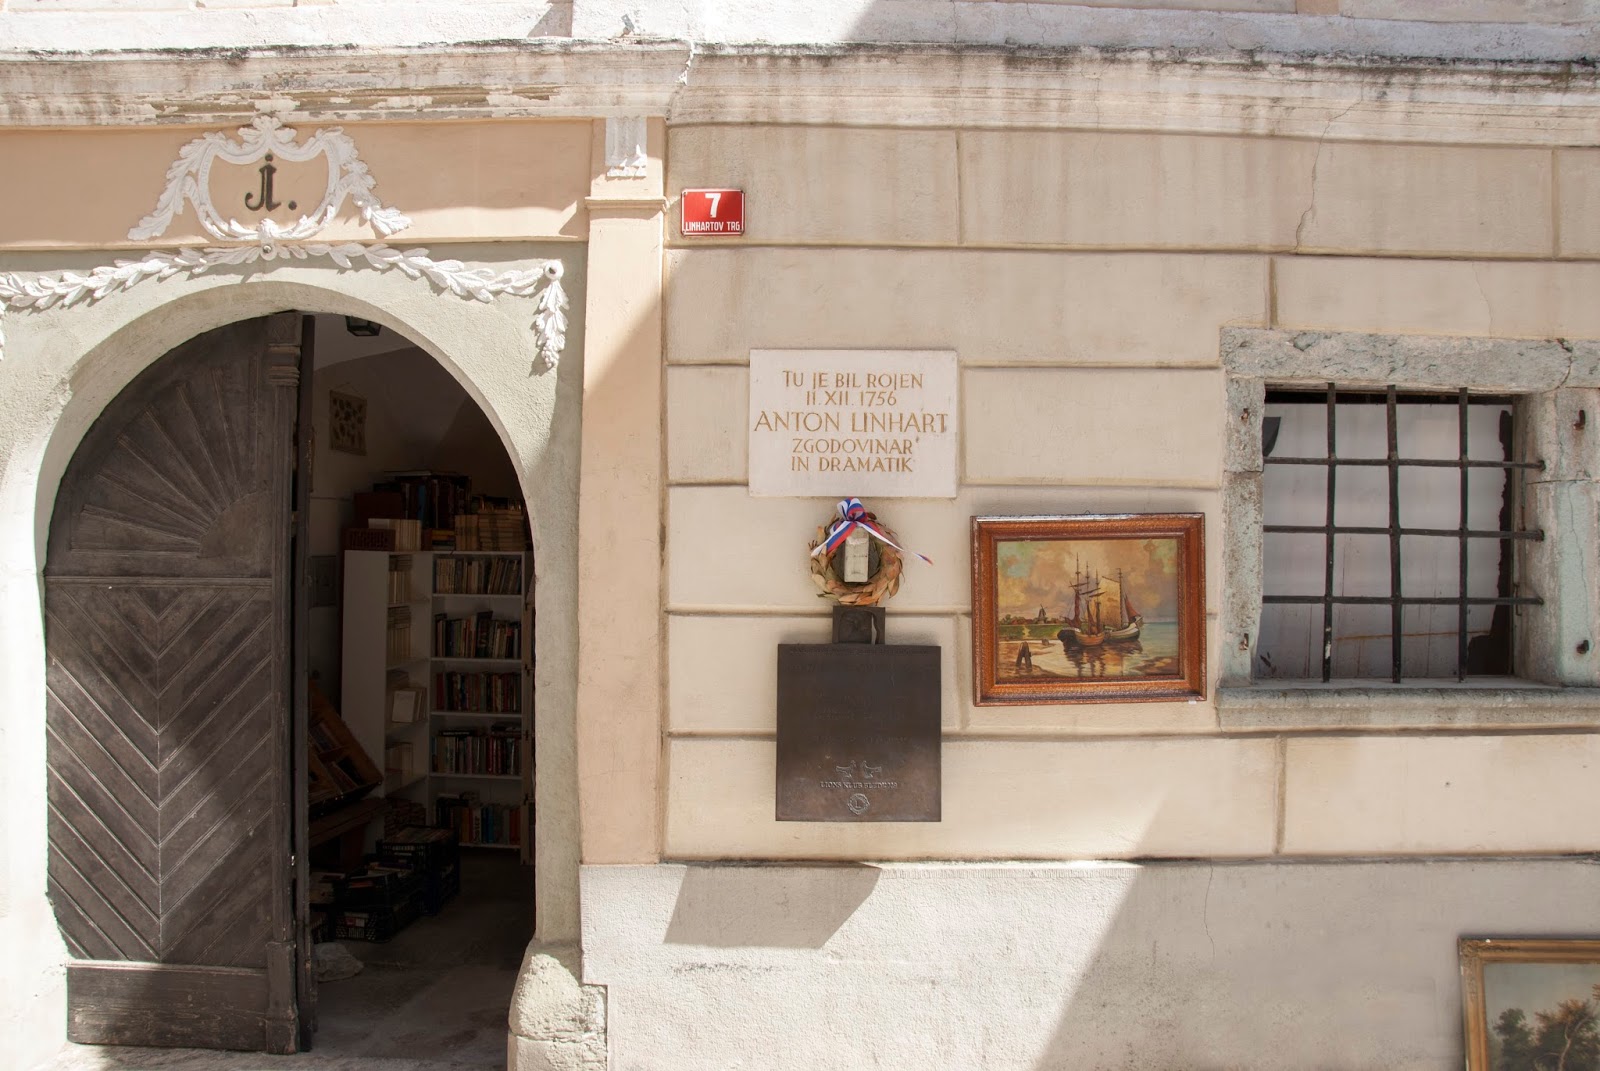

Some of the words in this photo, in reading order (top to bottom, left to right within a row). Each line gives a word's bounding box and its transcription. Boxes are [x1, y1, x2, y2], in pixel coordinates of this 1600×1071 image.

[705, 193, 721, 218] 7
[685, 221, 724, 231] LINHARTOV
[727, 221, 740, 231] TRG
[782, 370, 804, 387] TU
[813, 372, 828, 390] JE
[835, 373, 861, 388] BIL
[867, 373, 924, 391] ROJEN
[754, 411, 840, 432] ANTON
[851, 412, 948, 433] LINHART
[792, 438, 913, 455] ZGODOVINAR
[791, 456, 809, 471] IN
[819, 457, 913, 472] DRAMATIK
